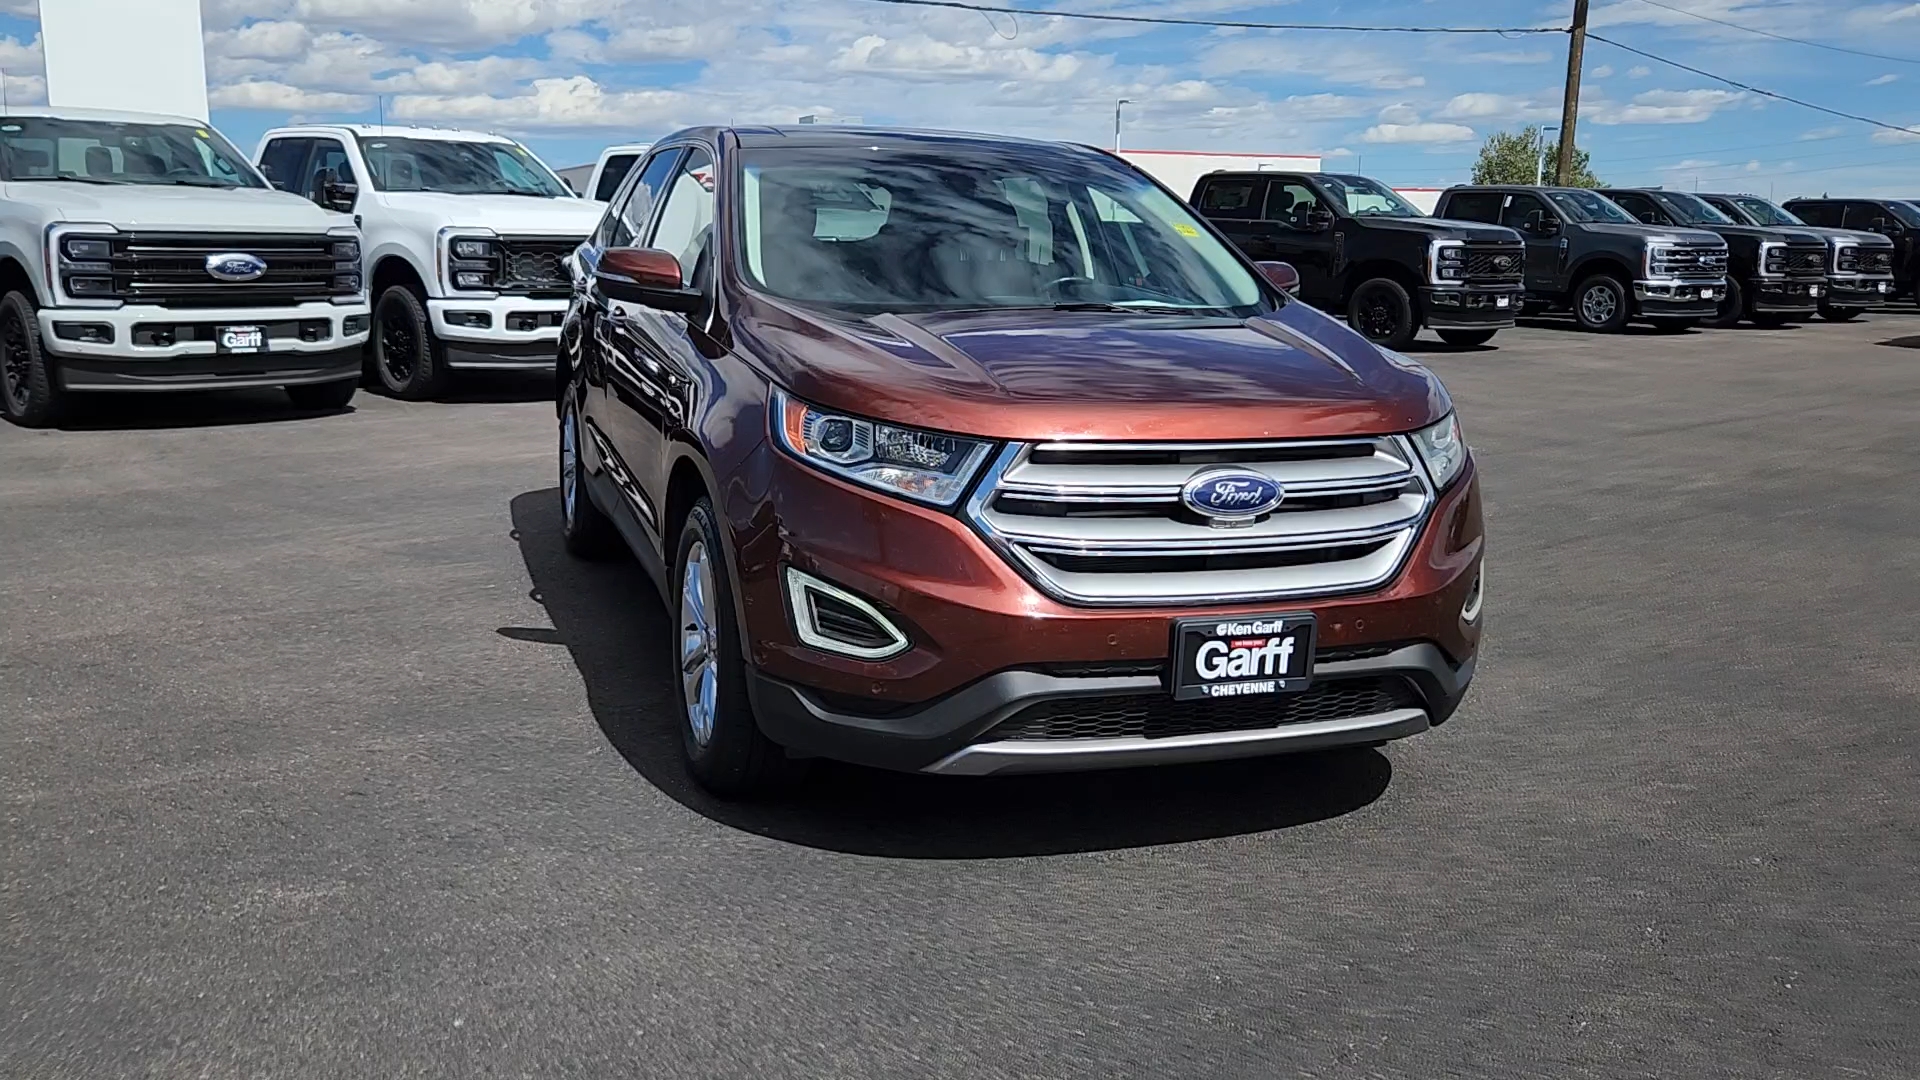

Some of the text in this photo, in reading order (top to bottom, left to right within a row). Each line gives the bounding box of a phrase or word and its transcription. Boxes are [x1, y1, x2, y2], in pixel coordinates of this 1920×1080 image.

[223, 332, 262, 347] Garff
[1210, 481, 1262, 505] Ford
[1252, 620, 1283, 634] Garff
[1196, 637, 1294, 679] Garff
[1211, 681, 1275, 696] CHEYENNE
